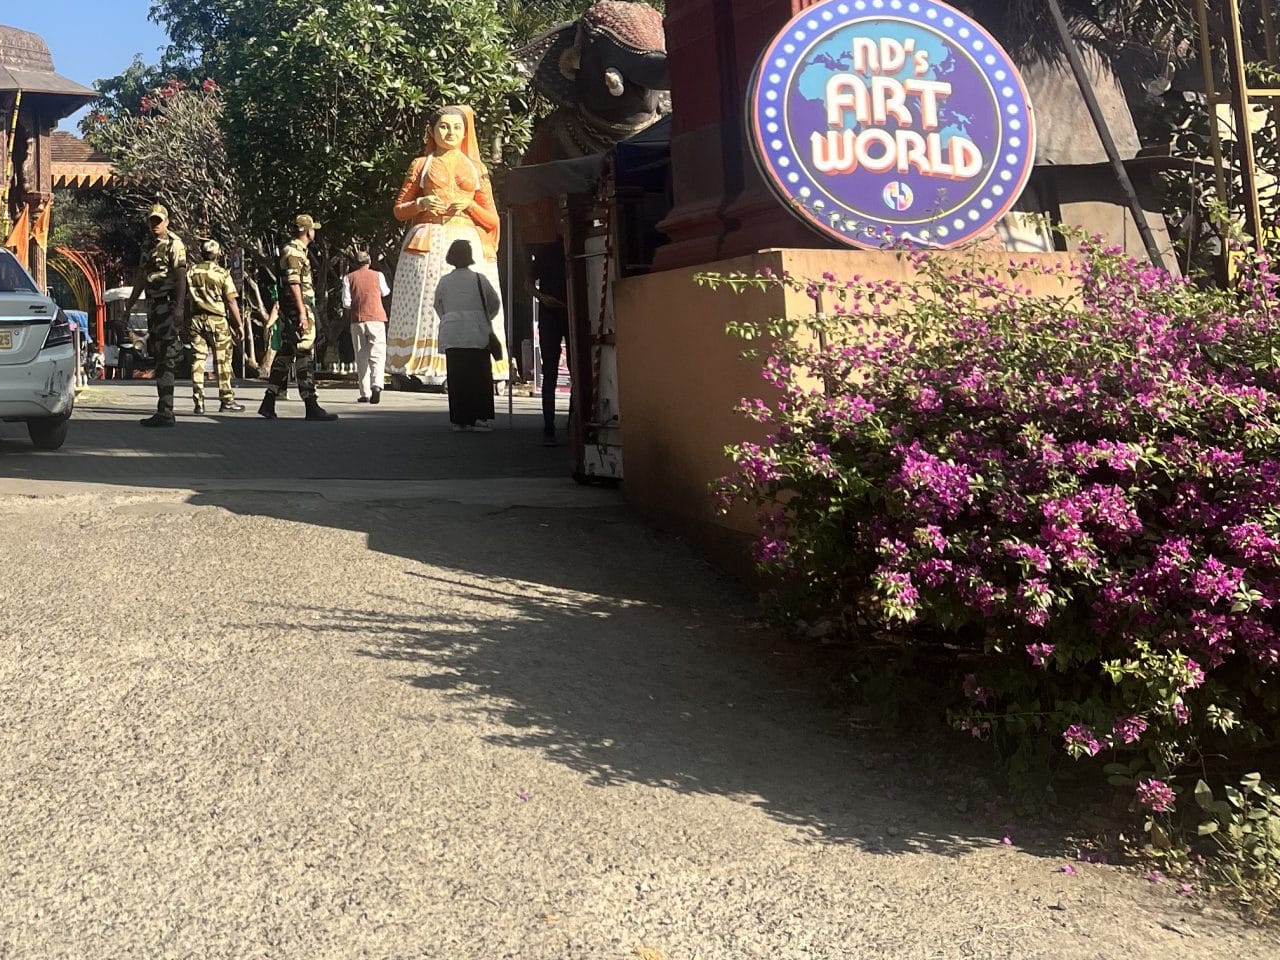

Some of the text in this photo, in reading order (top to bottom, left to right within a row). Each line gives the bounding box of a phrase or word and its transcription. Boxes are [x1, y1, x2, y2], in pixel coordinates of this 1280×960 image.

[852, 37, 930, 76] ND's
[825, 73, 953, 130] ART
[809, 128, 984, 180] WORLD
